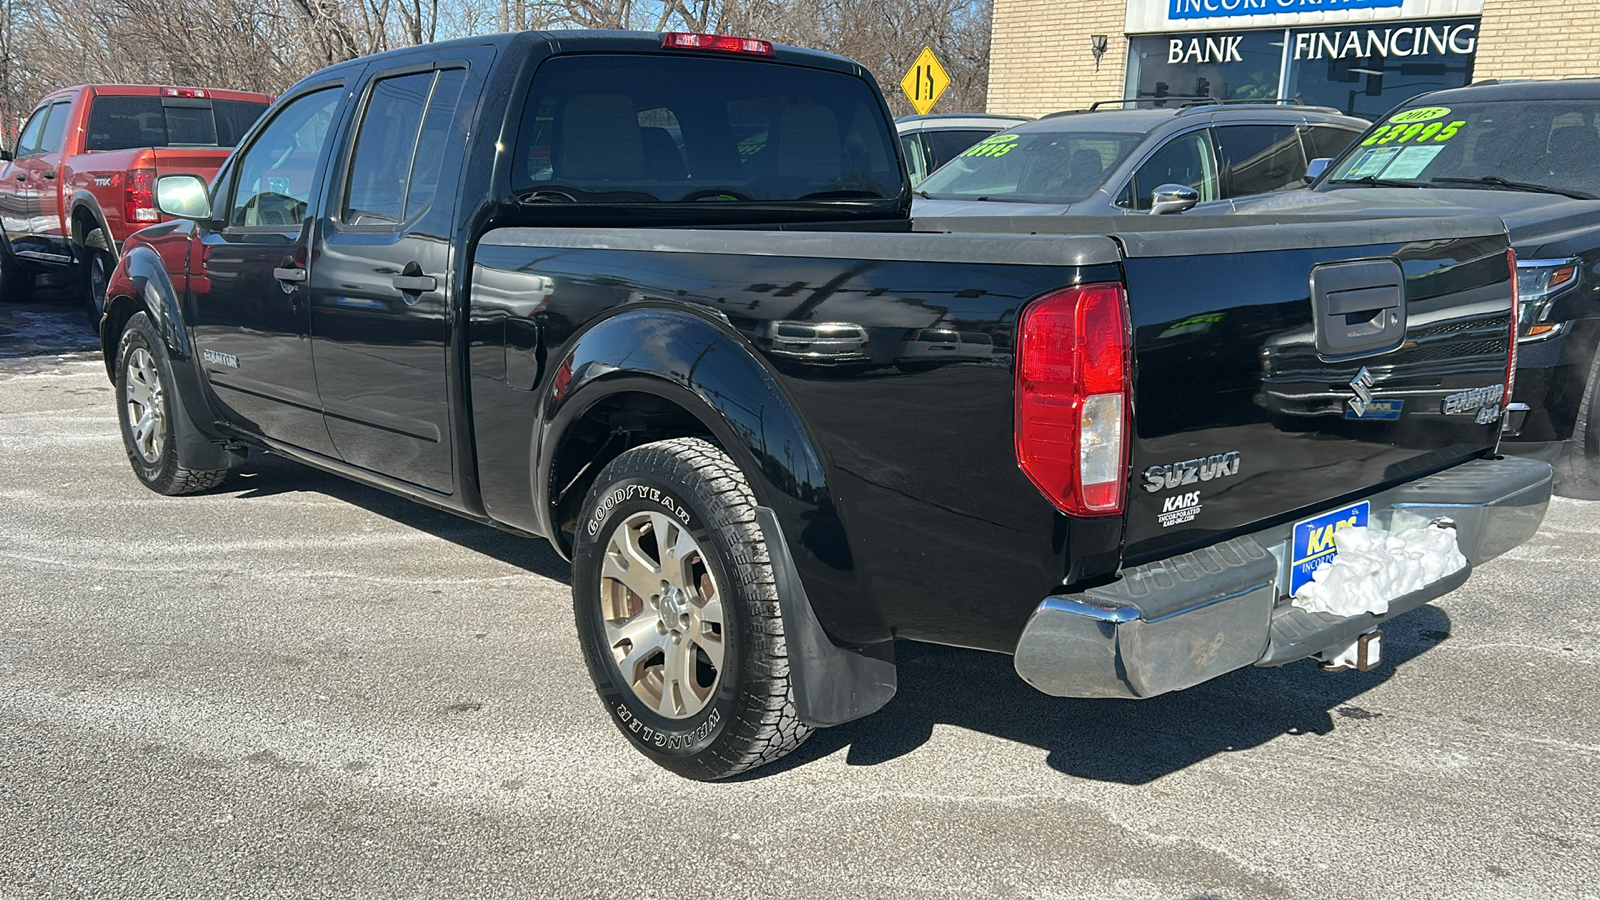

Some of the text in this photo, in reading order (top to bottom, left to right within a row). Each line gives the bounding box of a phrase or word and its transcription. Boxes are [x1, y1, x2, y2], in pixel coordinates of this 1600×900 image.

[1167, 24, 1476, 64] BANK FINANCING
[1396, 108, 1443, 122] 2015
[1360, 120, 1467, 147] 23995
[1442, 383, 1505, 416] EQUATOR
[1141, 450, 1241, 493] SUZUKI
[586, 484, 691, 538] GOODYEAR
[1162, 490, 1201, 513] KARS
[616, 705, 722, 750] WRANGLER
